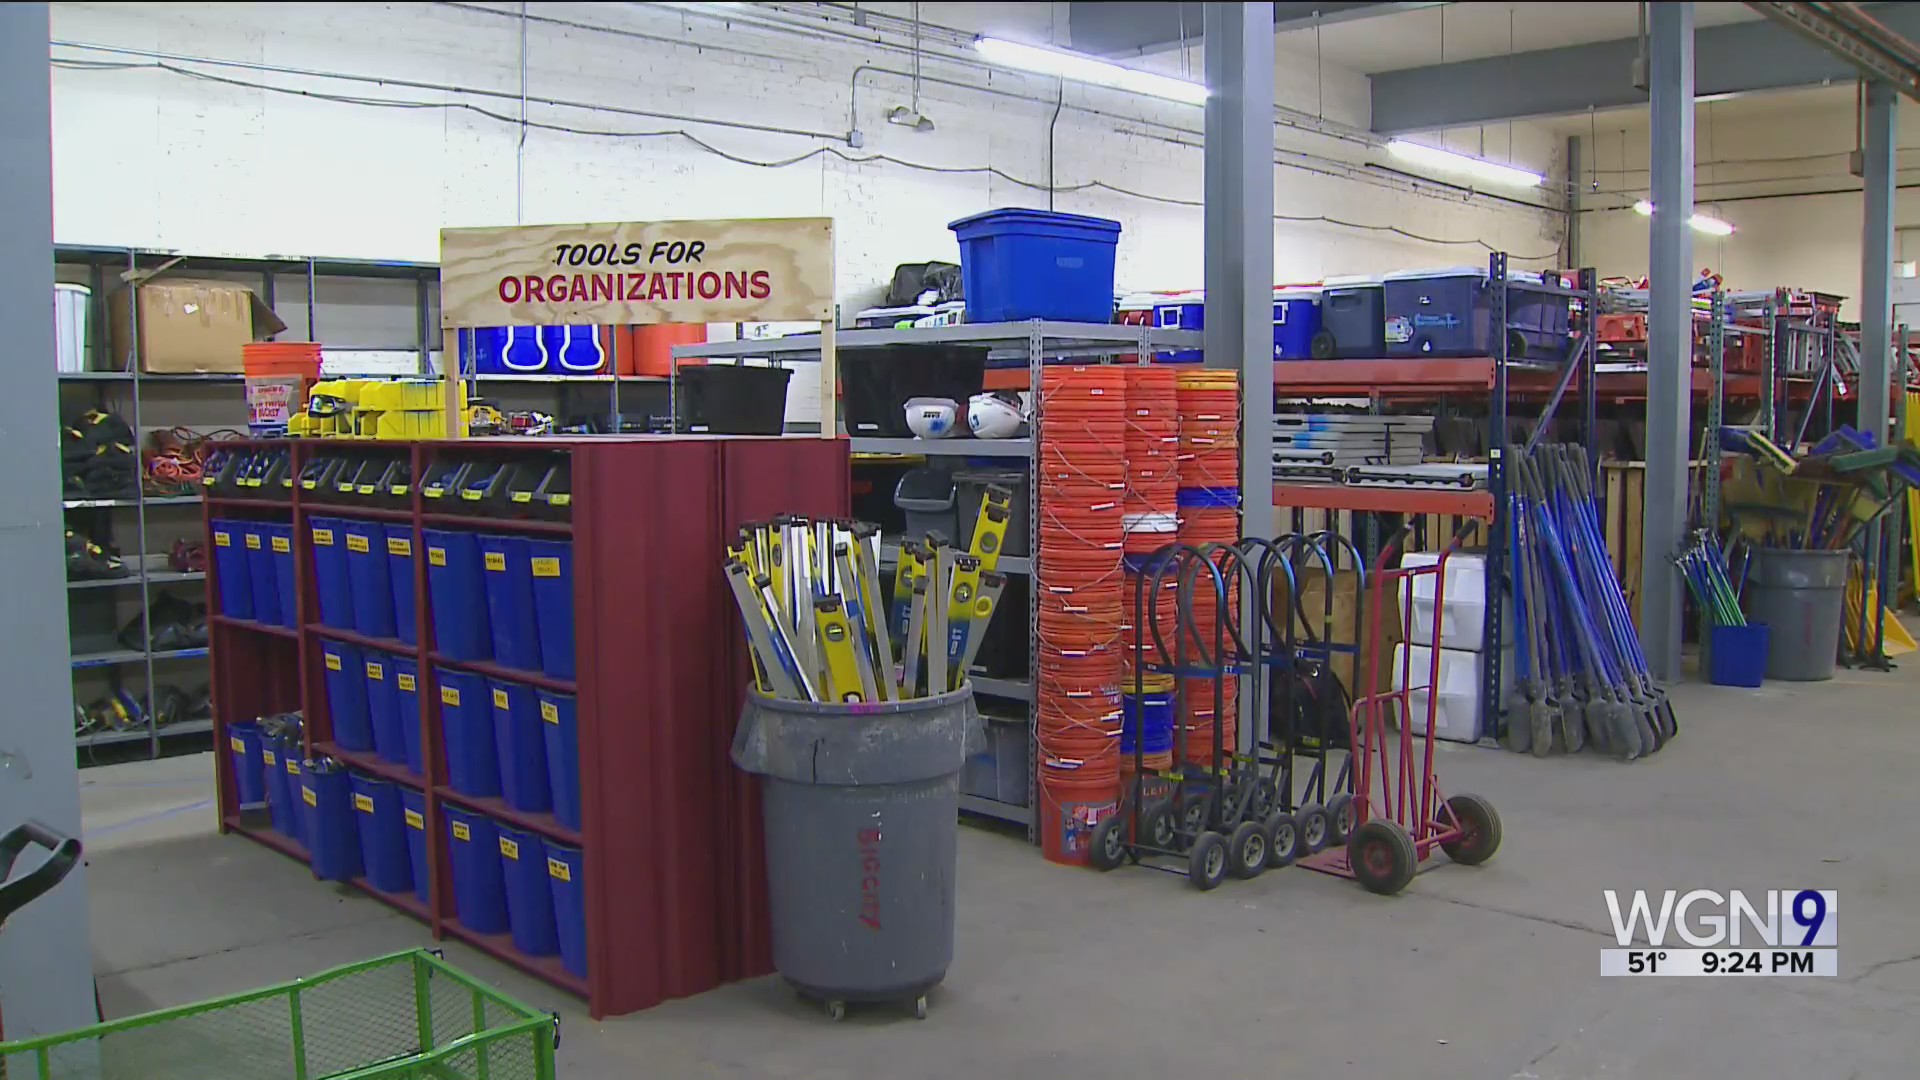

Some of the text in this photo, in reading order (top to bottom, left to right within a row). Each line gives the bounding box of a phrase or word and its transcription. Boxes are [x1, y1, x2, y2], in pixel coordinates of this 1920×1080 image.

[555, 240, 706, 267] TOOLS FOR
[498, 269, 772, 304] ORGANIZATIONS
